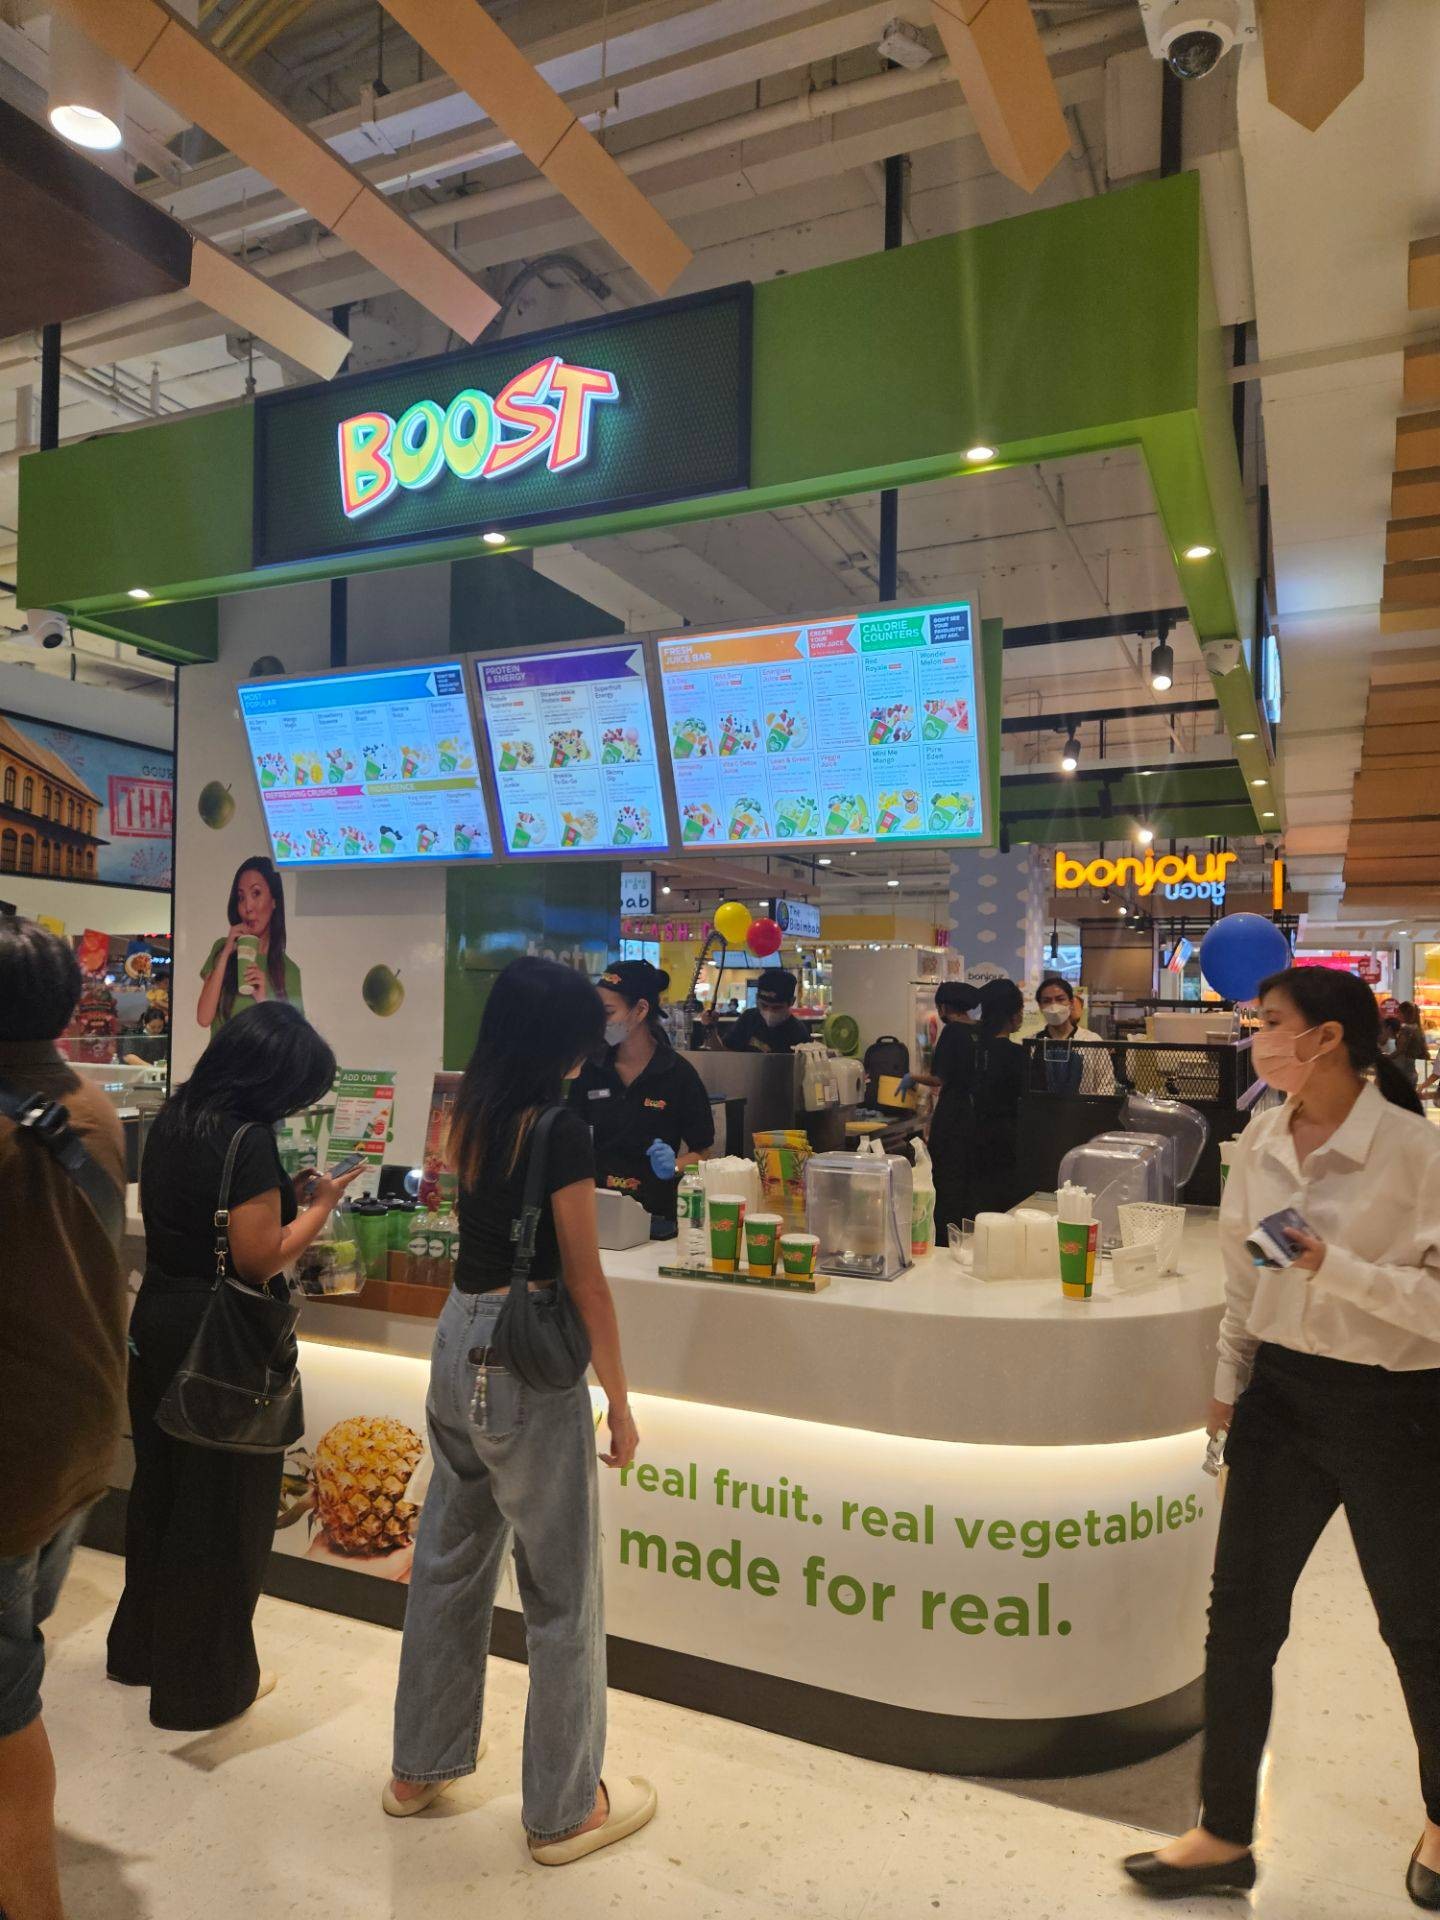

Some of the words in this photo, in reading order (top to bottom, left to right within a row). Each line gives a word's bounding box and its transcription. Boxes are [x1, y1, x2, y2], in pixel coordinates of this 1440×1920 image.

[338, 356, 620, 519] BOOST
[809, 629, 834, 637] CREATE
[862, 620, 908, 634] CALORIE
[862, 628, 920, 643] COUNTERS
[664, 646, 693, 655] FRESH
[665, 655, 691, 665] JUICE
[692, 652, 712, 662] BAR
[485, 665, 520, 676] PROTEIN
[494, 673, 526, 684] ENERGY
[244, 700, 277, 709] POPULAR
[265, 791, 306, 800] REFRESHING
[307, 788, 338, 798] CRUSHES
[1055, 848, 1238, 896] bonjour
[361, 1074, 378, 1082] ONS
[620, 1461, 697, 1500] real
[714, 1468, 824, 1525] fruit.
[841, 1500, 934, 1545] real
[954, 1491, 1204, 1559] vegetables.
[620, 1527, 781, 1597] made
[802, 1556, 896, 1622] for
[921, 1583, 1073, 1636] real.
